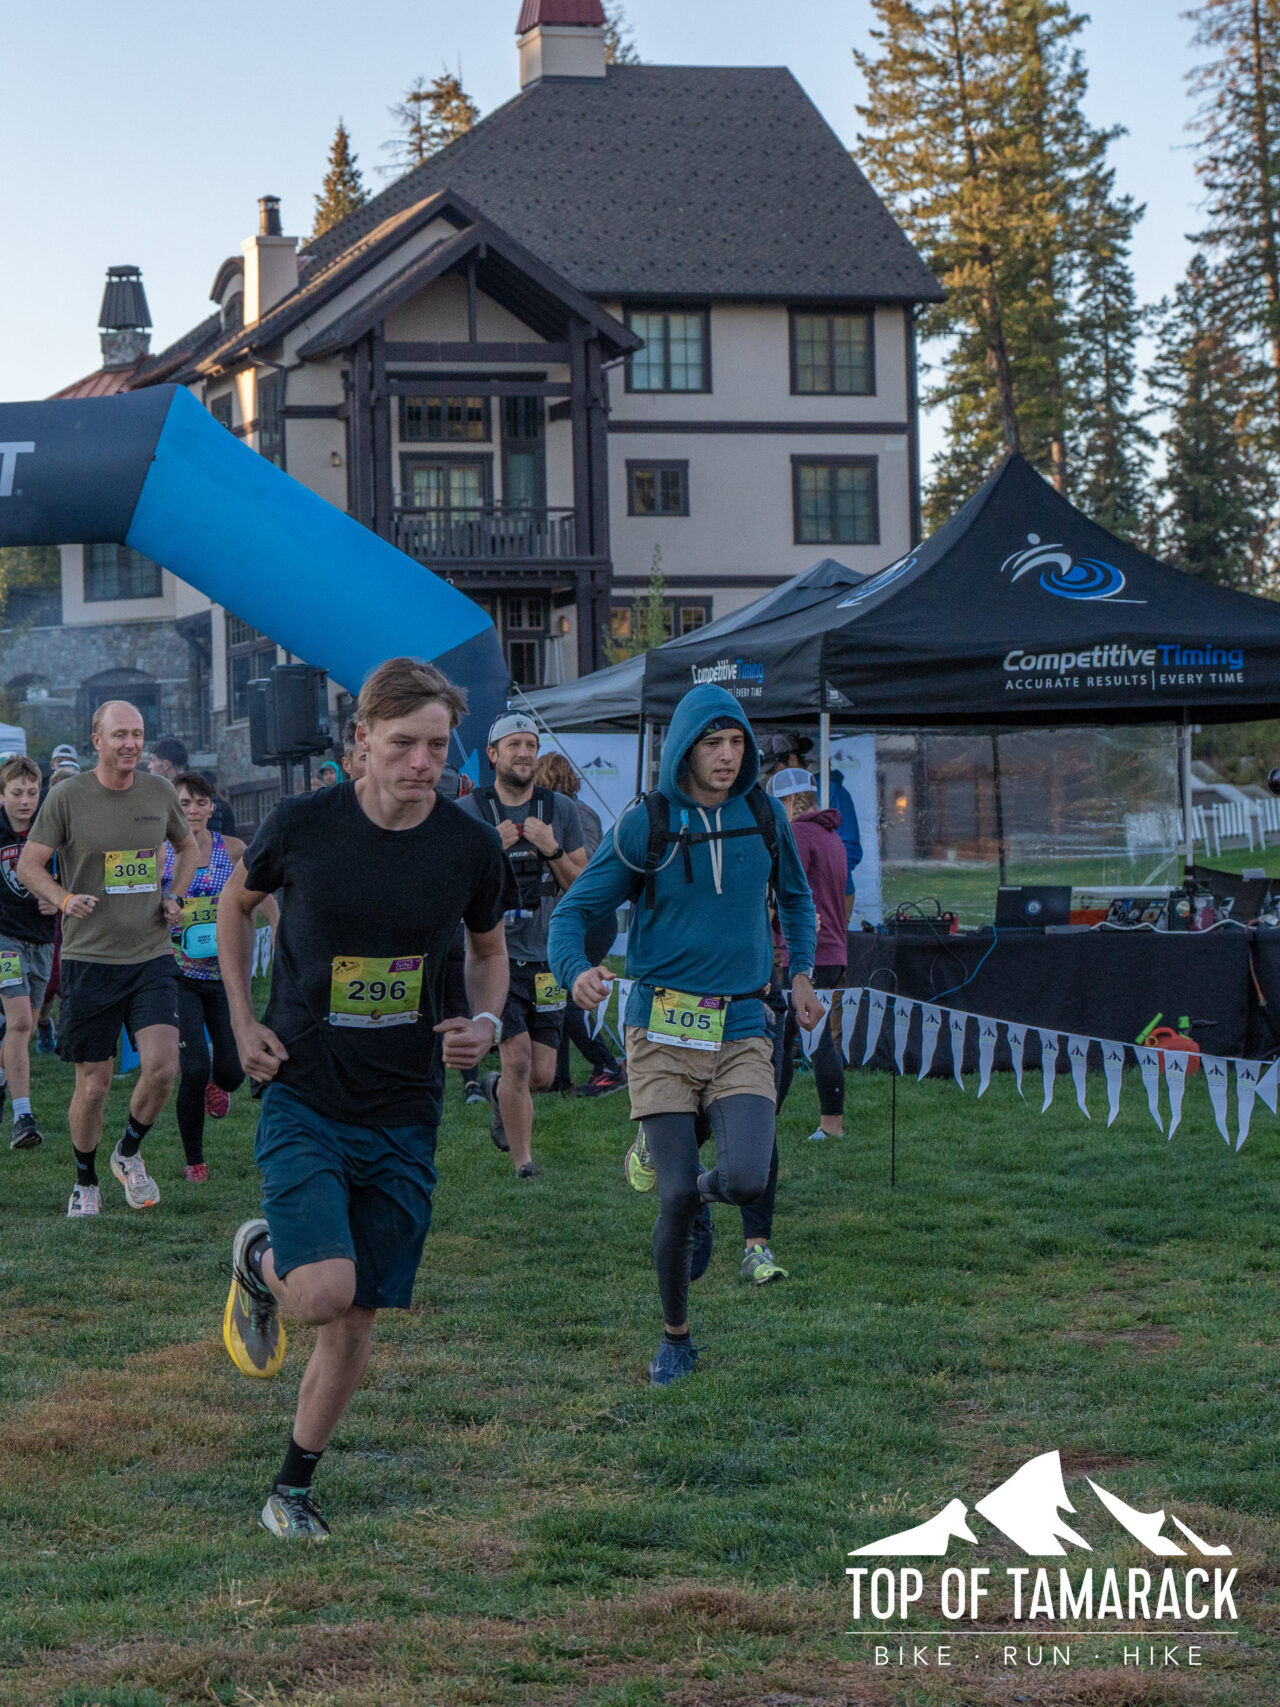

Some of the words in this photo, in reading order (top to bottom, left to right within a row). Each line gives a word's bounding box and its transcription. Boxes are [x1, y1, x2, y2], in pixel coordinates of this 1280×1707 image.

[1005, 677, 1080, 690] ACCURATE
[1087, 674, 1148, 688] RESULTS
[1160, 673, 1204, 685] EVERY
[1209, 672, 1245, 684] TIME
[736, 687, 750, 698] EVERY
[751, 686, 763, 697] TIME
[114, 863, 148, 878] 308
[347, 980, 408, 1002] 296
[665, 1009, 712, 1031] 105
